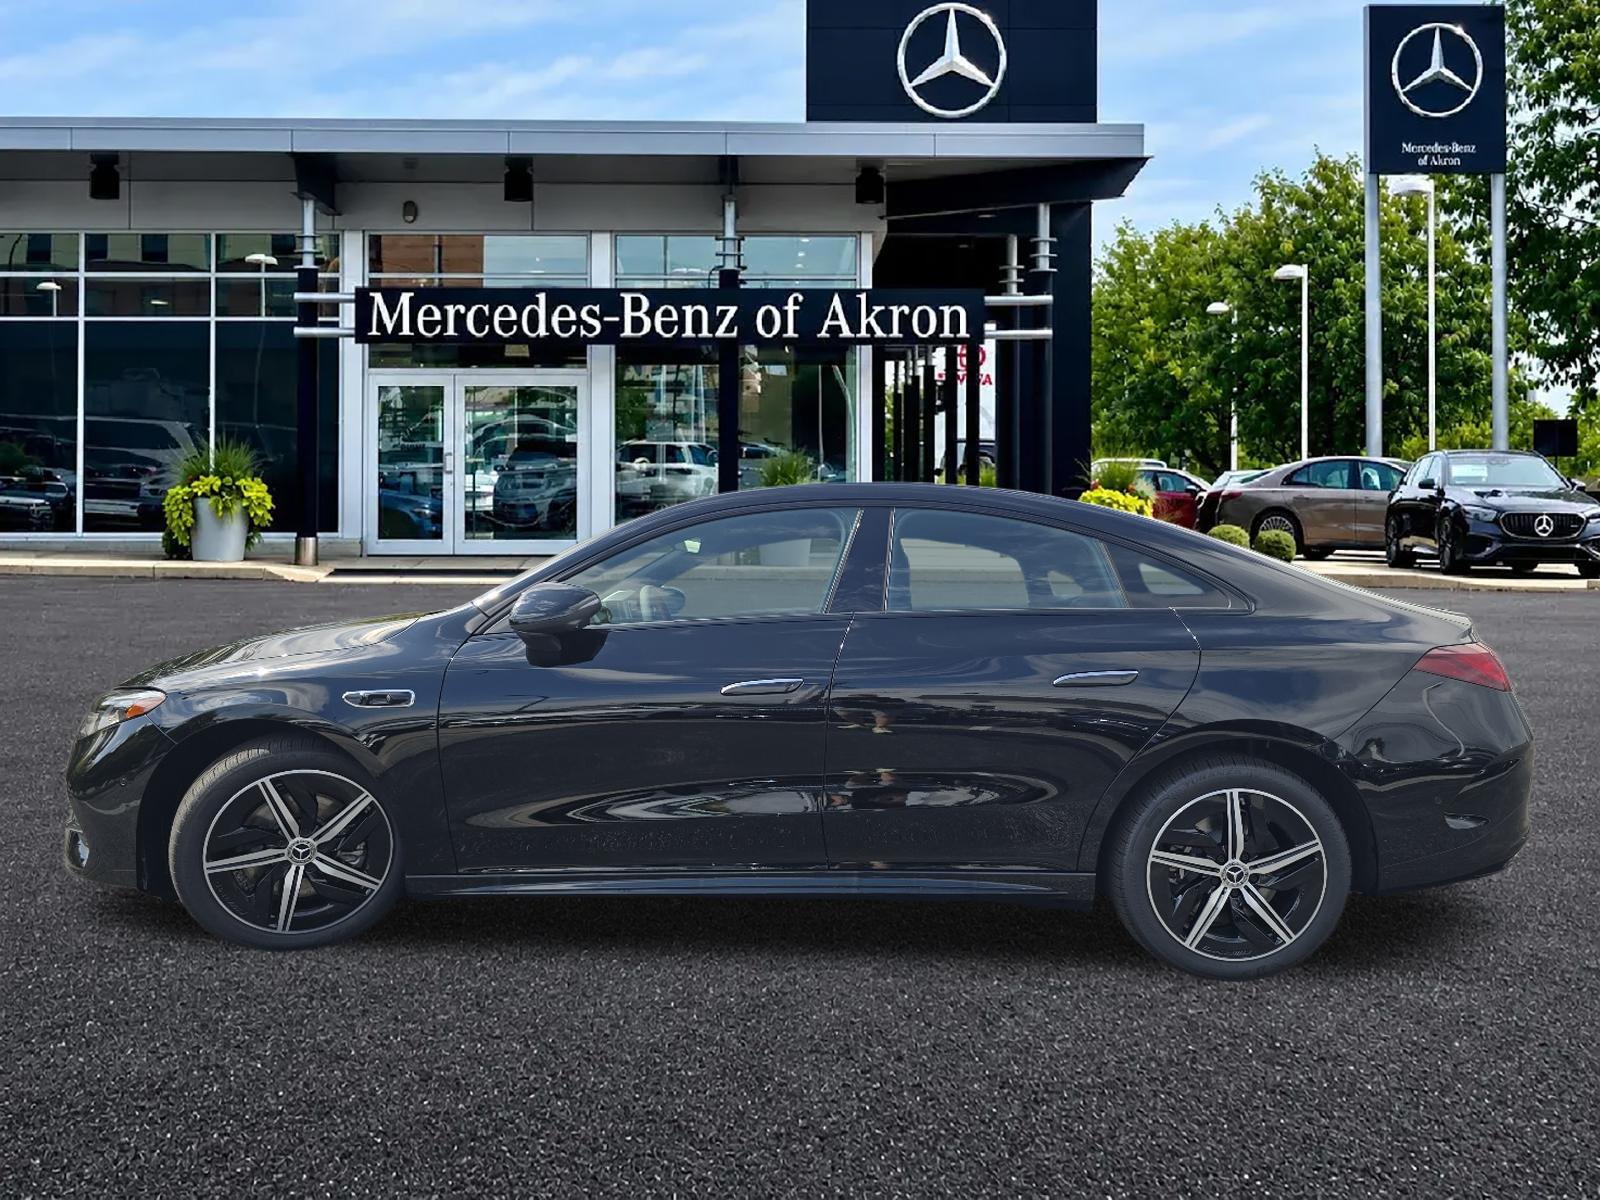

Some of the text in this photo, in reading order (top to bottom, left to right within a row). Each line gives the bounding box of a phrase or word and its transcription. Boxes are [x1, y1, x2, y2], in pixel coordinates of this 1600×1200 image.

[1401, 141, 1477, 154] Mercedes-Benz
[1417, 154, 1461, 166] of Akron
[367, 292, 970, 338] Mercedes-Benz of Akron
